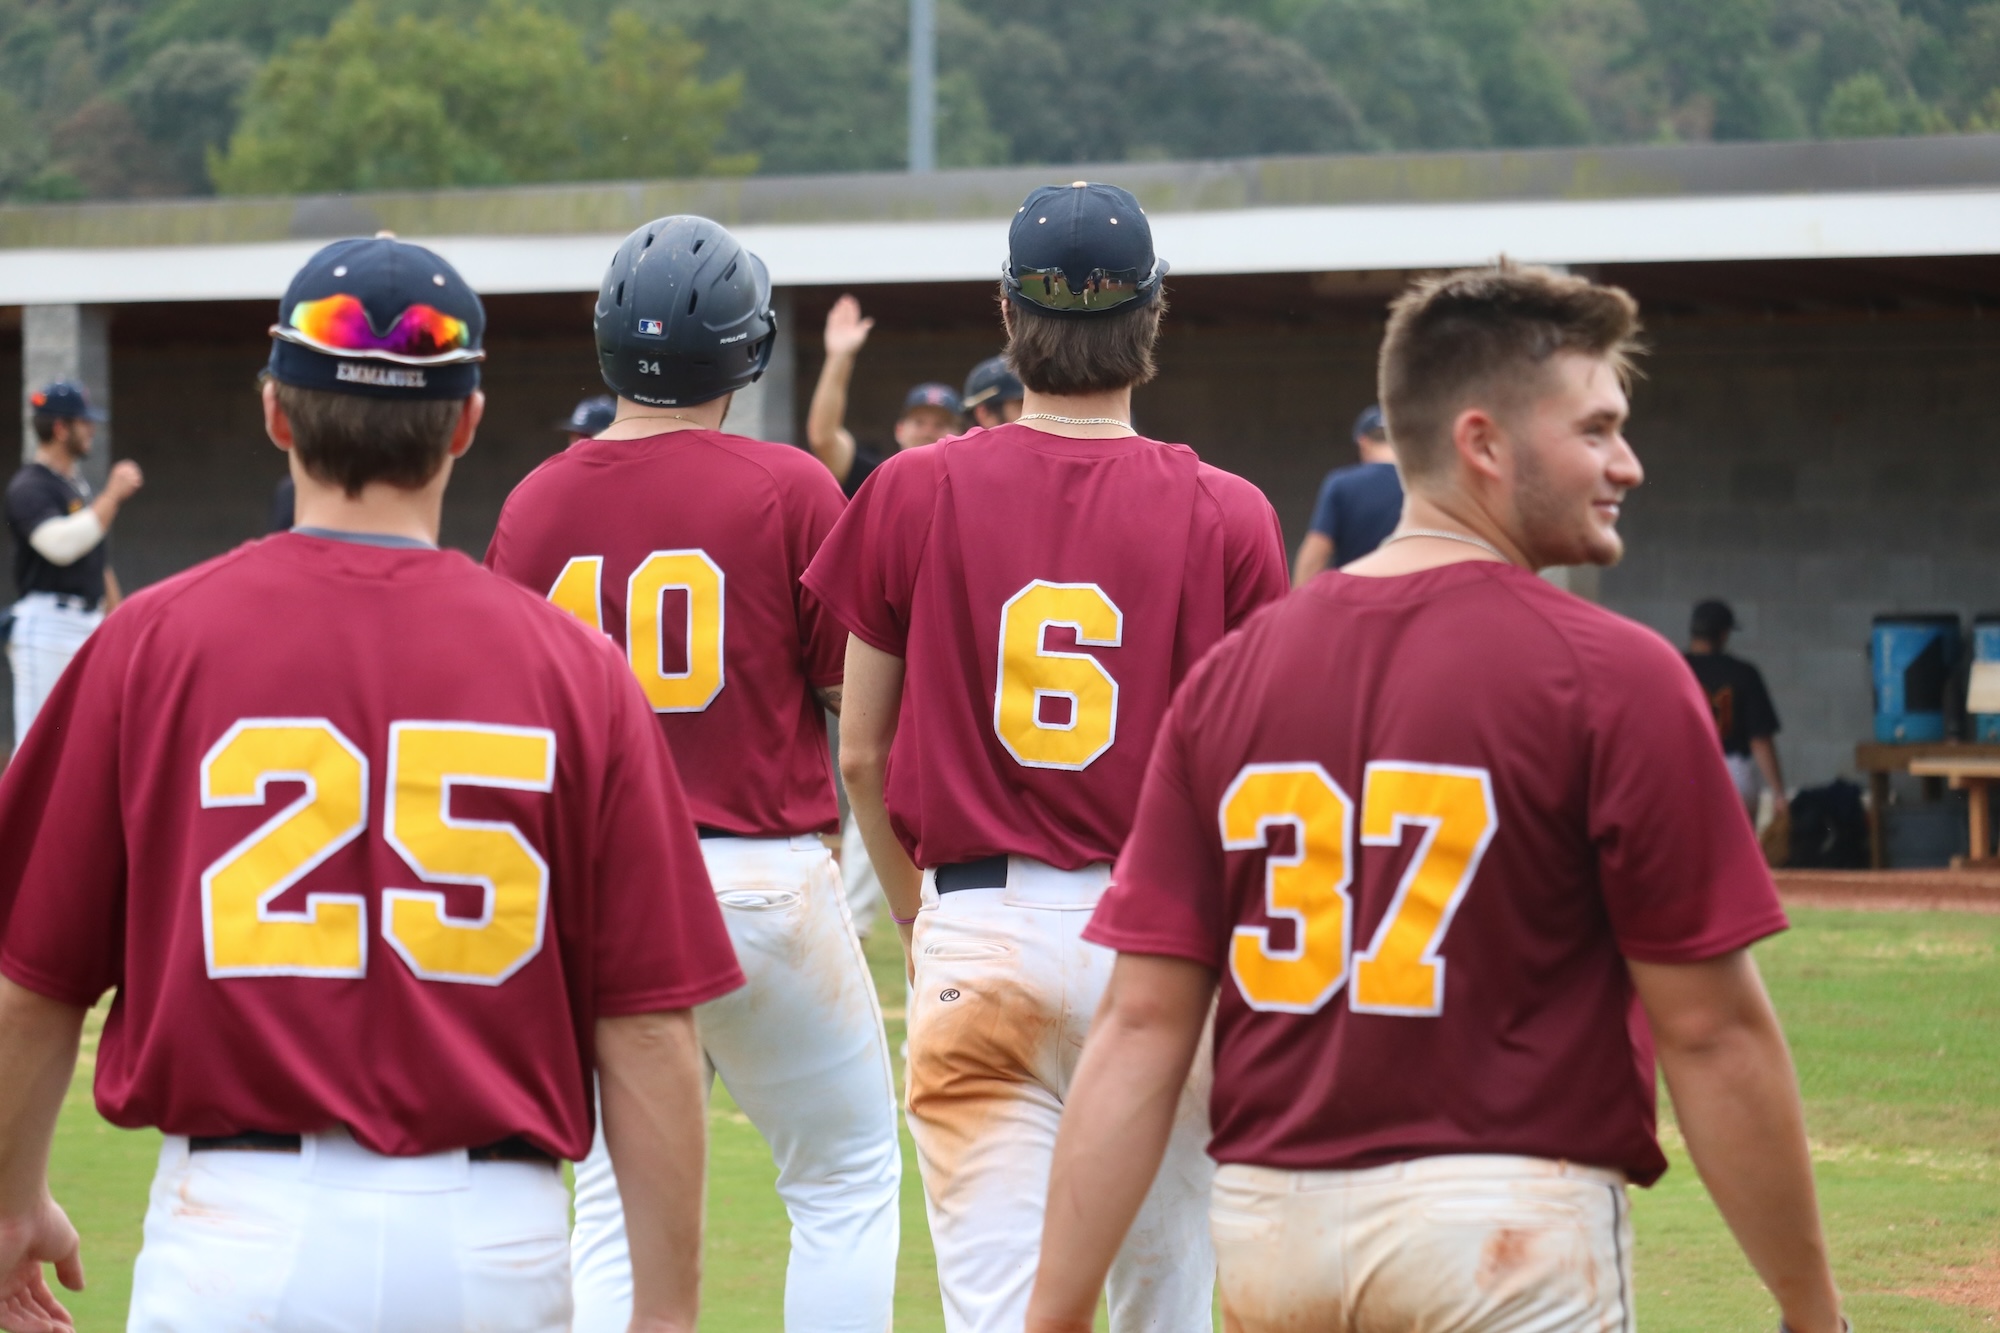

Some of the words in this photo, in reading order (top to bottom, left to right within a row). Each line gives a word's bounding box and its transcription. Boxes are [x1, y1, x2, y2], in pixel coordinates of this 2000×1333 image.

[335, 362, 428, 388] EMMANUEL
[638, 360, 661, 376] 34
[993, 578, 1124, 771] 6
[200, 717, 557, 986] 25
[1218, 760, 1499, 1017] 37
